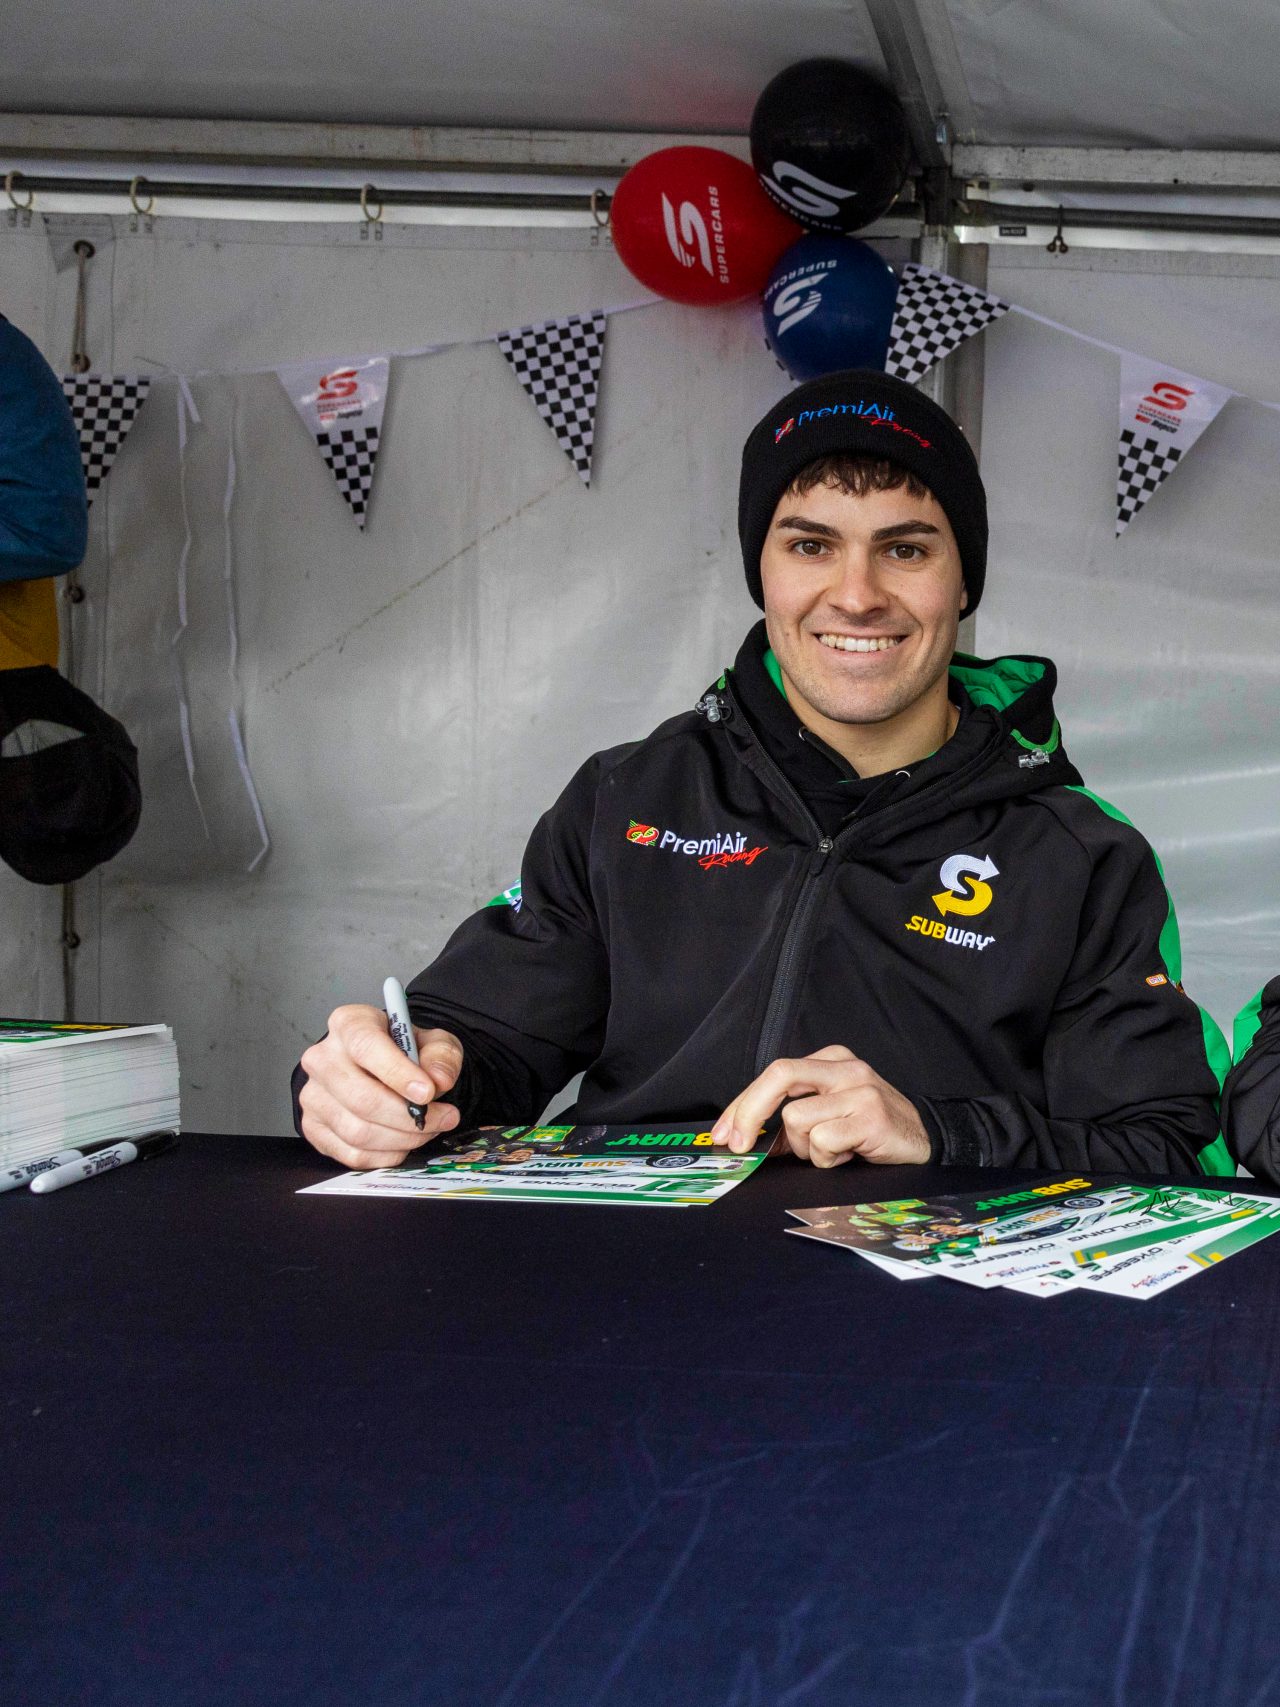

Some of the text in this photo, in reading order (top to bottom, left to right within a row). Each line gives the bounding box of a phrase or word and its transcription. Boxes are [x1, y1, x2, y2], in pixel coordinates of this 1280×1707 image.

[708, 186, 730, 284] SUPERCARS
[798, 400, 898, 426] PremiAir
[659, 829, 748, 856] PremiAir
[698, 846, 769, 871] Racing
[904, 915, 996, 951] SUBWAY
[521, 1159, 633, 1170] SUBWAY
[975, 1178, 1092, 1211] SUBWAY
[993, 1209, 1062, 1237] SUBWAY
[1066, 1218, 1155, 1243] GOLDING
[949, 1242, 1056, 1269] O'KEEFFE
[1086, 1246, 1164, 1282] O'KEEFFE
